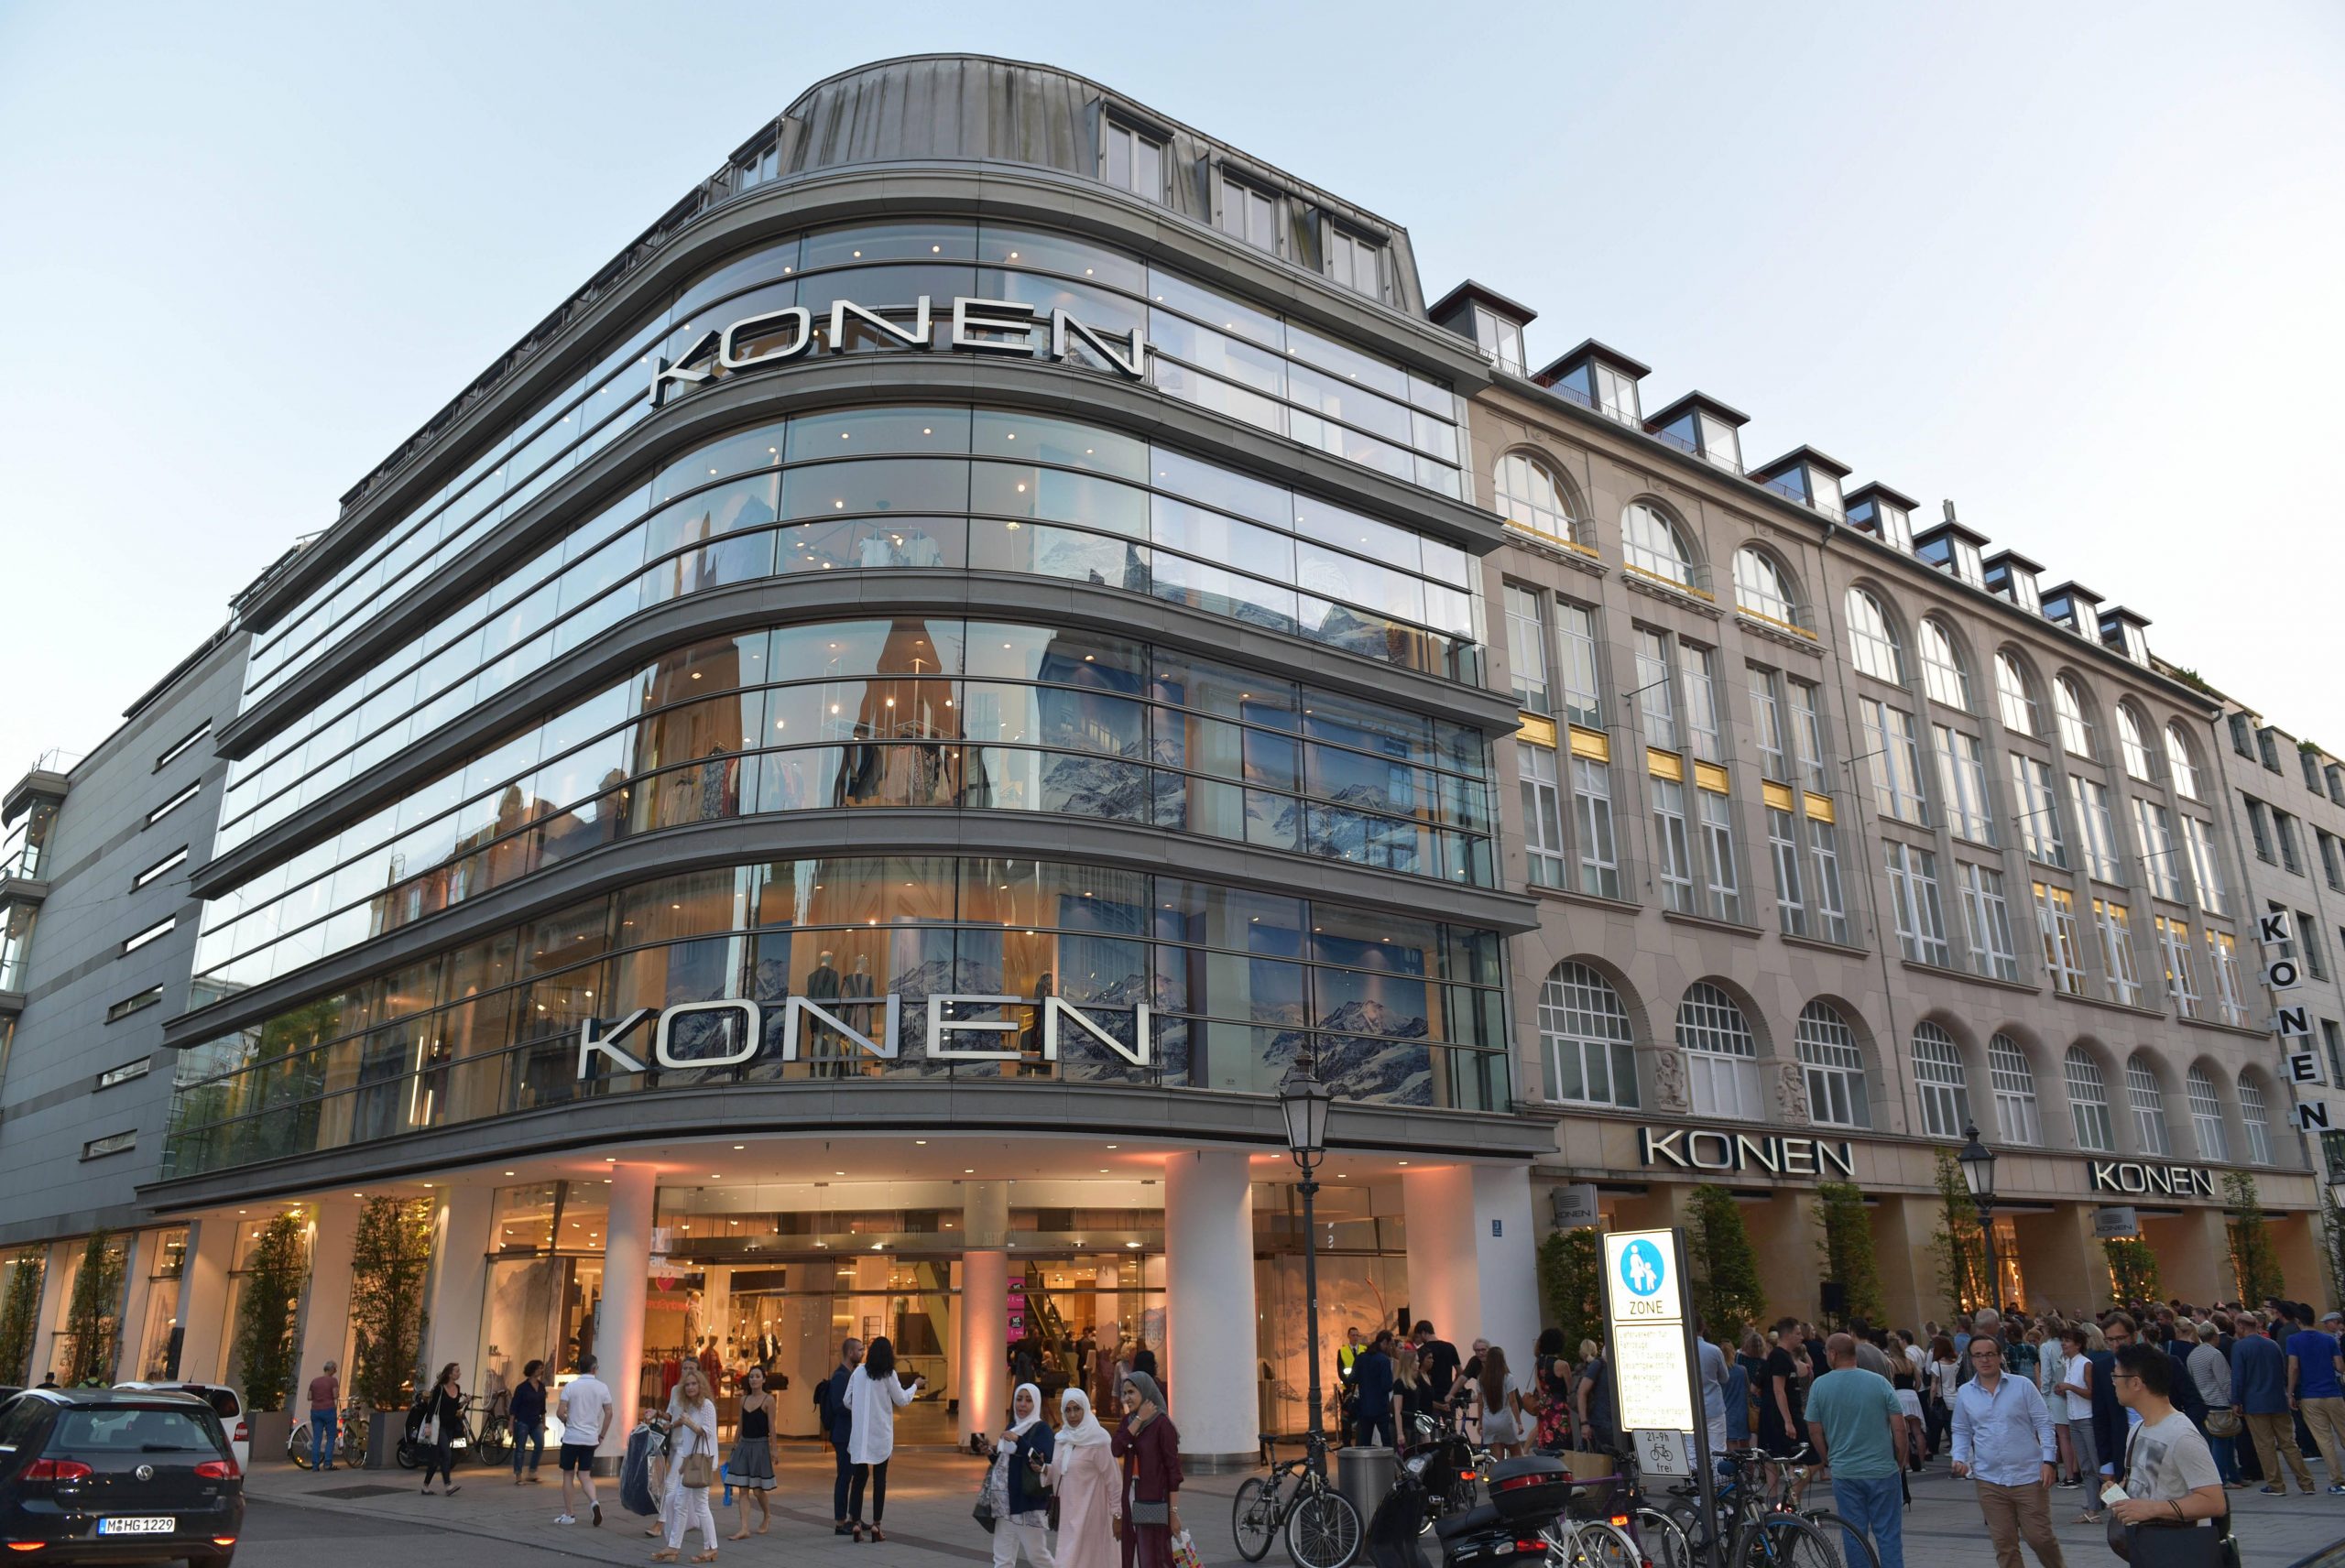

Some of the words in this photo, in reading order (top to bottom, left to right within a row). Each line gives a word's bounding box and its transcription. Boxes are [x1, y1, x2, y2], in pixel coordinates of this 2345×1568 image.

[649, 295, 1145, 408] KONEN
[2261, 914, 2329, 1130] KONEN
[577, 993, 1151, 1079] KONEN
[1640, 1127, 1856, 1176] KONEN
[2089, 1160, 2216, 1195] KONEN
[1554, 1209, 1591, 1219] KONEN
[2097, 1224, 2132, 1232] KONEN
[1630, 1301, 1663, 1315] ZONE
[1646, 1432, 1670, 1442] 21-9h
[1656, 1463, 1673, 1473] frei
[125, 1519, 140, 1531] HG
[143, 1519, 173, 1531] 1229
